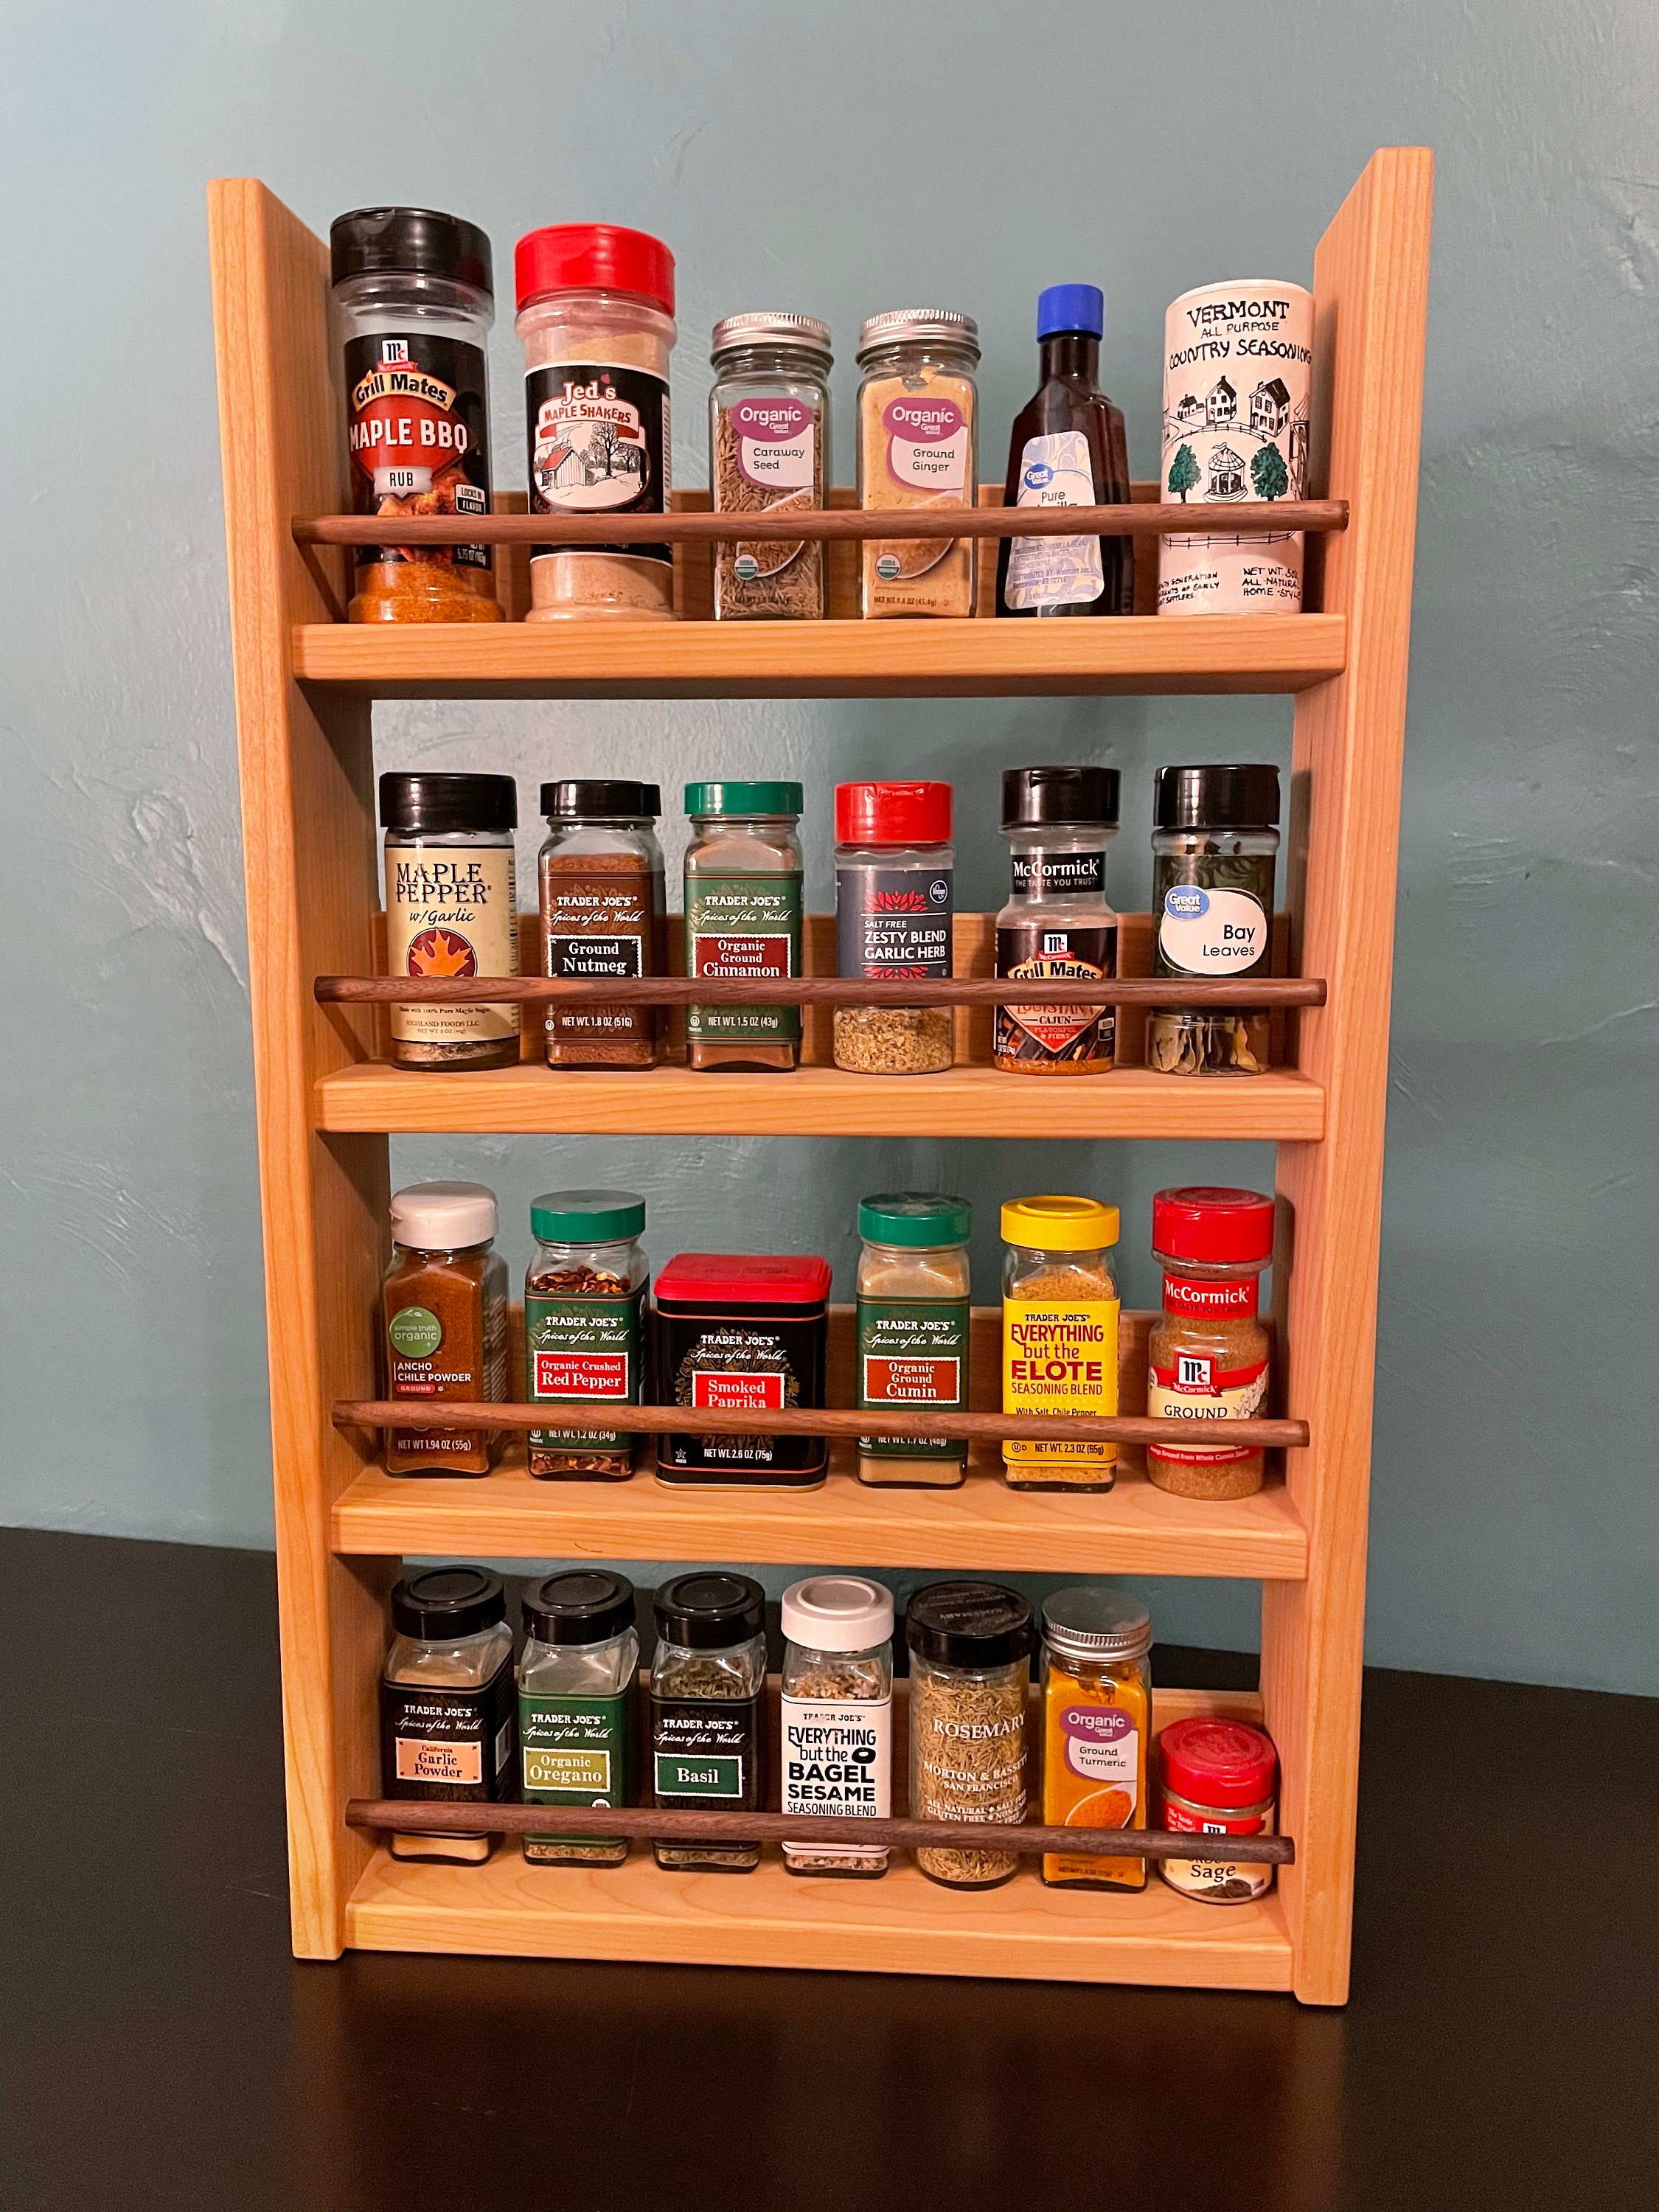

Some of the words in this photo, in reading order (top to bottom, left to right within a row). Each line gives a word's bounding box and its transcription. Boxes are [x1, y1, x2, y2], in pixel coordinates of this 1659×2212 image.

[1187, 300, 1289, 327] VERMONT
[1201, 327, 1222, 339] ALL
[1227, 321, 1280, 334] PURPOSE
[1169, 341, 1230, 370] COUNTRY
[1236, 339, 1312, 365] SEASONING
[356, 374, 384, 405] Grill
[391, 374, 448, 403] Mates
[544, 406, 577, 423] MAPLE
[580, 404, 632, 423] SHAKERS
[740, 406, 802, 426] Organic
[892, 406, 954, 426] Organic
[350, 418, 413, 452] MAPLE
[420, 419, 467, 454] BBQ
[754, 448, 805, 459] Caraway
[913, 448, 955, 459] Ground
[754, 461, 780, 470] Seed
[913, 462, 950, 472] Ginger
[389, 472, 414, 487] RUB
[1042, 490, 1065, 503] Pure
[1243, 567, 1265, 575] NET
[1242, 578, 1262, 586] ALL
[1244, 588, 1273, 596] HOME
[397, 863, 482, 884] MAPLE
[1013, 859, 1098, 877] McCormick
[1054, 878, 1071, 886] YOU
[397, 884, 488, 904] PEPPER
[1169, 893, 1200, 905] Great
[557, 897, 599, 906] TRADER
[602, 897, 632, 906] JOE'S
[704, 897, 748, 906] TRADER
[750, 897, 781, 906] JOE'S
[1175, 903, 1200, 913] Value
[409, 908, 476, 925] w/Garlic
[547, 911, 581, 926] Spices
[613, 911, 644, 922] World
[694, 910, 728, 925] Spices
[762, 910, 792, 922] World
[864, 920, 883, 928] SALT
[886, 920, 907, 928] FREE
[864, 932, 908, 944] ZESTY
[911, 930, 946, 943] BLEND
[1223, 925, 1255, 942] Bay
[568, 942, 619, 955] Ground
[718, 940, 765, 953] Organic
[864, 947, 914, 959] GARLIC
[917, 945, 945, 959] HERB
[1203, 945, 1255, 956] Leaves
[720, 953, 762, 963] Ground
[562, 957, 627, 975] Nutmeg
[703, 962, 780, 977] Cinnamon
[1014, 962, 1044, 978] Grill
[1050, 962, 1097, 978] Mates
[562, 1017, 575, 1026] NET
[591, 1017, 602, 1026] 1.8
[604, 1017, 613, 1026] OZ
[614, 1018, 633, 1028] (51G)
[709, 1017, 721, 1026] NET
[738, 1017, 748, 1026] 1.5
[750, 1017, 759, 1026] OZ
[761, 1017, 778, 1028] (43g)
[1040, 1016, 1071, 1024] CAJUN
[1165, 1279, 1248, 1304] McCormick
[546, 1317, 587, 1326] TRADER
[588, 1318, 618, 1326] JOE'S
[1025, 1314, 1059, 1322] TRADER
[1062, 1314, 1087, 1322] JOE'S
[876, 1321, 918, 1330] TRADER
[920, 1321, 950, 1330] JOE'S
[394, 1331, 437, 1341] organic
[536, 1329, 569, 1344] Spices
[599, 1329, 630, 1341] World
[700, 1335, 743, 1345] TRADER
[745, 1336, 773, 1346] JOE'S
[865, 1334, 899, 1348] Spices
[931, 1334, 961, 1346] World
[1011, 1324, 1104, 1345] EVERYTHING
[690, 1348, 724, 1363] Spices
[756, 1349, 787, 1360] World
[1023, 1343, 1049, 1359] but
[1054, 1343, 1079, 1359] the
[397, 1363, 432, 1371] ANCHO
[541, 1360, 580, 1371] Organic
[582, 1362, 621, 1371] Crushed
[888, 1362, 935, 1374] Organic
[1012, 1360, 1102, 1381] ELOTE
[398, 1373, 425, 1382] CHILE
[428, 1374, 471, 1382] POWDER
[541, 1372, 569, 1386] Red
[572, 1372, 622, 1389] Pepper
[891, 1374, 932, 1384] Ground
[708, 1380, 765, 1394] Smoked
[886, 1383, 937, 1398] Cumin
[1012, 1382, 1068, 1395] SEASONING
[1071, 1384, 1102, 1395] BLEND
[1173, 1382, 1217, 1394] McCormick
[708, 1394, 766, 1408] Paprika
[1164, 1405, 1228, 1419] GROUND
[398, 1440, 411, 1450] NET
[413, 1440, 425, 1450] WT
[425, 1440, 440, 1450] 1.94
[442, 1441, 451, 1450] OZ
[452, 1441, 471, 1451] (55g)
[1035, 1443, 1048, 1452] NET
[1065, 1444, 1075, 1453] 2.3
[1077, 1444, 1085, 1453] OZ
[1087, 1444, 1104, 1455] (65g)
[704, 1449, 717, 1457] NET
[732, 1450, 742, 1458] 2.6
[745, 1450, 754, 1458] OZ
[755, 1450, 772, 1461] (75g)
[404, 1705, 442, 1716] TRADER
[444, 1708, 473, 1717] JOE'S
[395, 1717, 425, 1731] Spices
[455, 1719, 484, 1731] World
[532, 1714, 571, 1723] TRADER
[573, 1715, 601, 1725] JOE'S
[663, 1719, 703, 1729] TRADER
[705, 1720, 734, 1730] JOE'S
[933, 1710, 1026, 1739] ROSEMARY
[1068, 1712, 1125, 1729] Organic
[523, 1726, 554, 1740] Spices
[584, 1728, 613, 1739] World
[654, 1731, 684, 1746] Spices
[716, 1733, 745, 1744] World
[788, 1725, 877, 1747] EVERYTHING
[422, 1745, 453, 1753] California
[800, 1745, 823, 1761] but
[826, 1746, 848, 1761] the
[1079, 1747, 1118, 1756] Ground
[418, 1753, 457, 1765] Garlic
[541, 1755, 591, 1769] Organic
[1079, 1757, 1126, 1767] Turmeric
[414, 1764, 463, 1778] Powder
[789, 1762, 875, 1784] BAGEL
[924, 1761, 976, 1781] MORTON
[980, 1772, 990, 1781] &
[993, 1753, 1028, 1779] BASSETT
[530, 1765, 602, 1784] Oregano
[676, 1767, 719, 1784] Basil
[943, 1781, 964, 1791] SAN
[967, 1775, 1018, 1792] FRANCISCO
[788, 1784, 875, 1801] SESAME
[788, 1801, 843, 1815] SEASONING
[845, 1805, 877, 1817] BLEND
[927, 1806, 961, 1822] GLUTEN
[945, 1805, 986, 1815] NATURAL
[1191, 1865, 1237, 1882] Sage
